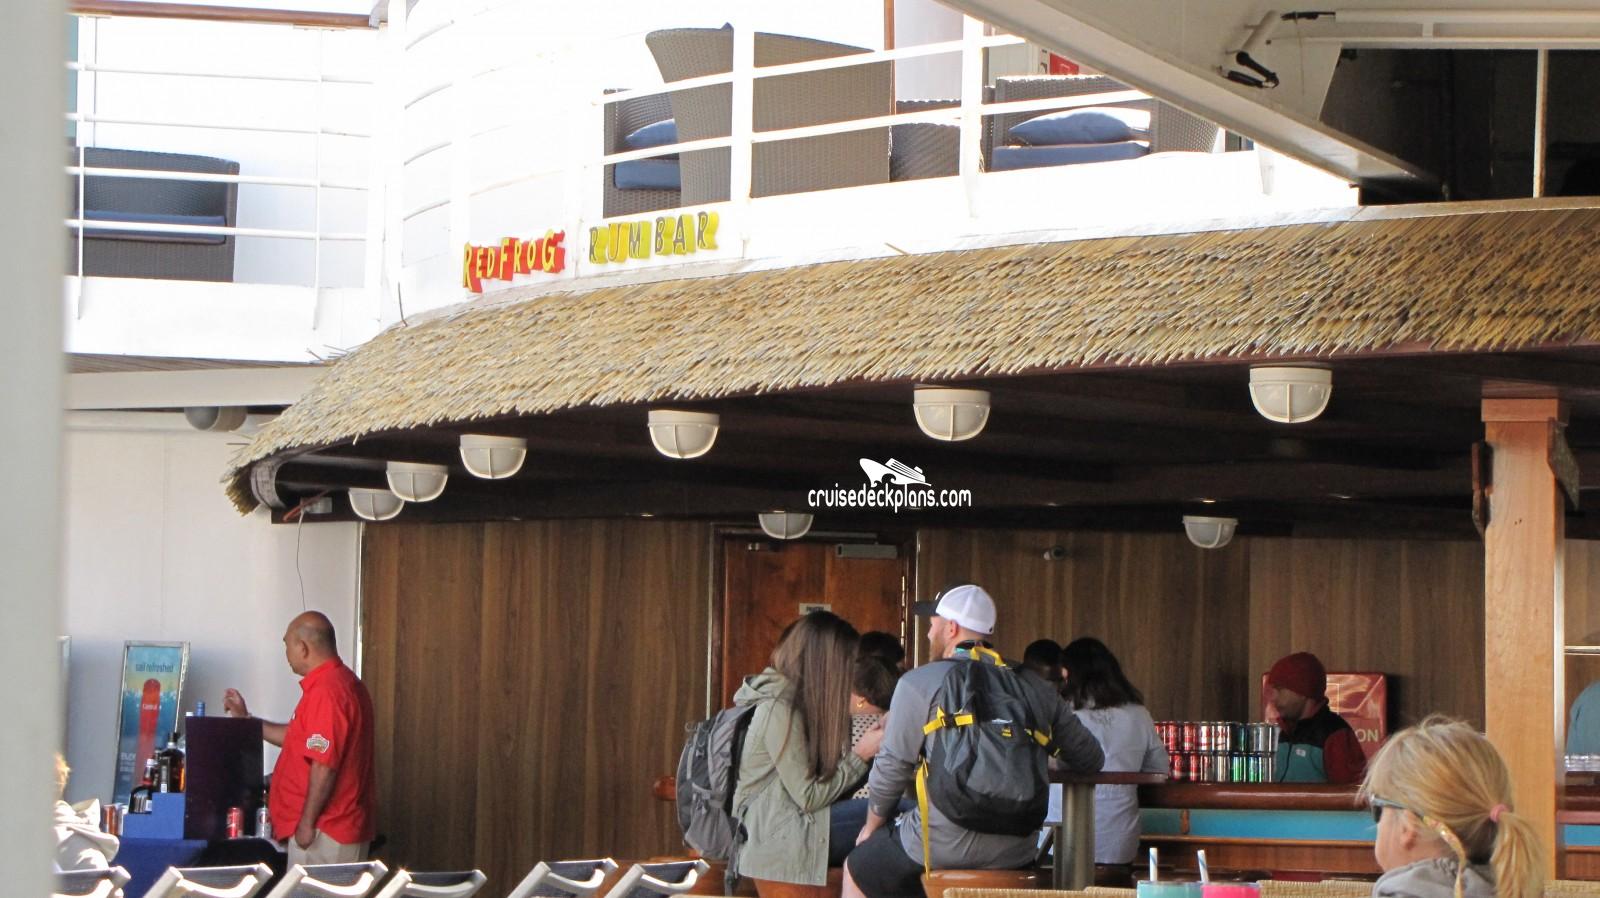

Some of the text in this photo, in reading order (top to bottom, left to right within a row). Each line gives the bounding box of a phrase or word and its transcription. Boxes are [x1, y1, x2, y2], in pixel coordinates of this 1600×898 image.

[589, 221, 651, 264] RUM
[654, 211, 719, 256] BAR
[147, 662, 174, 673] refreshed
